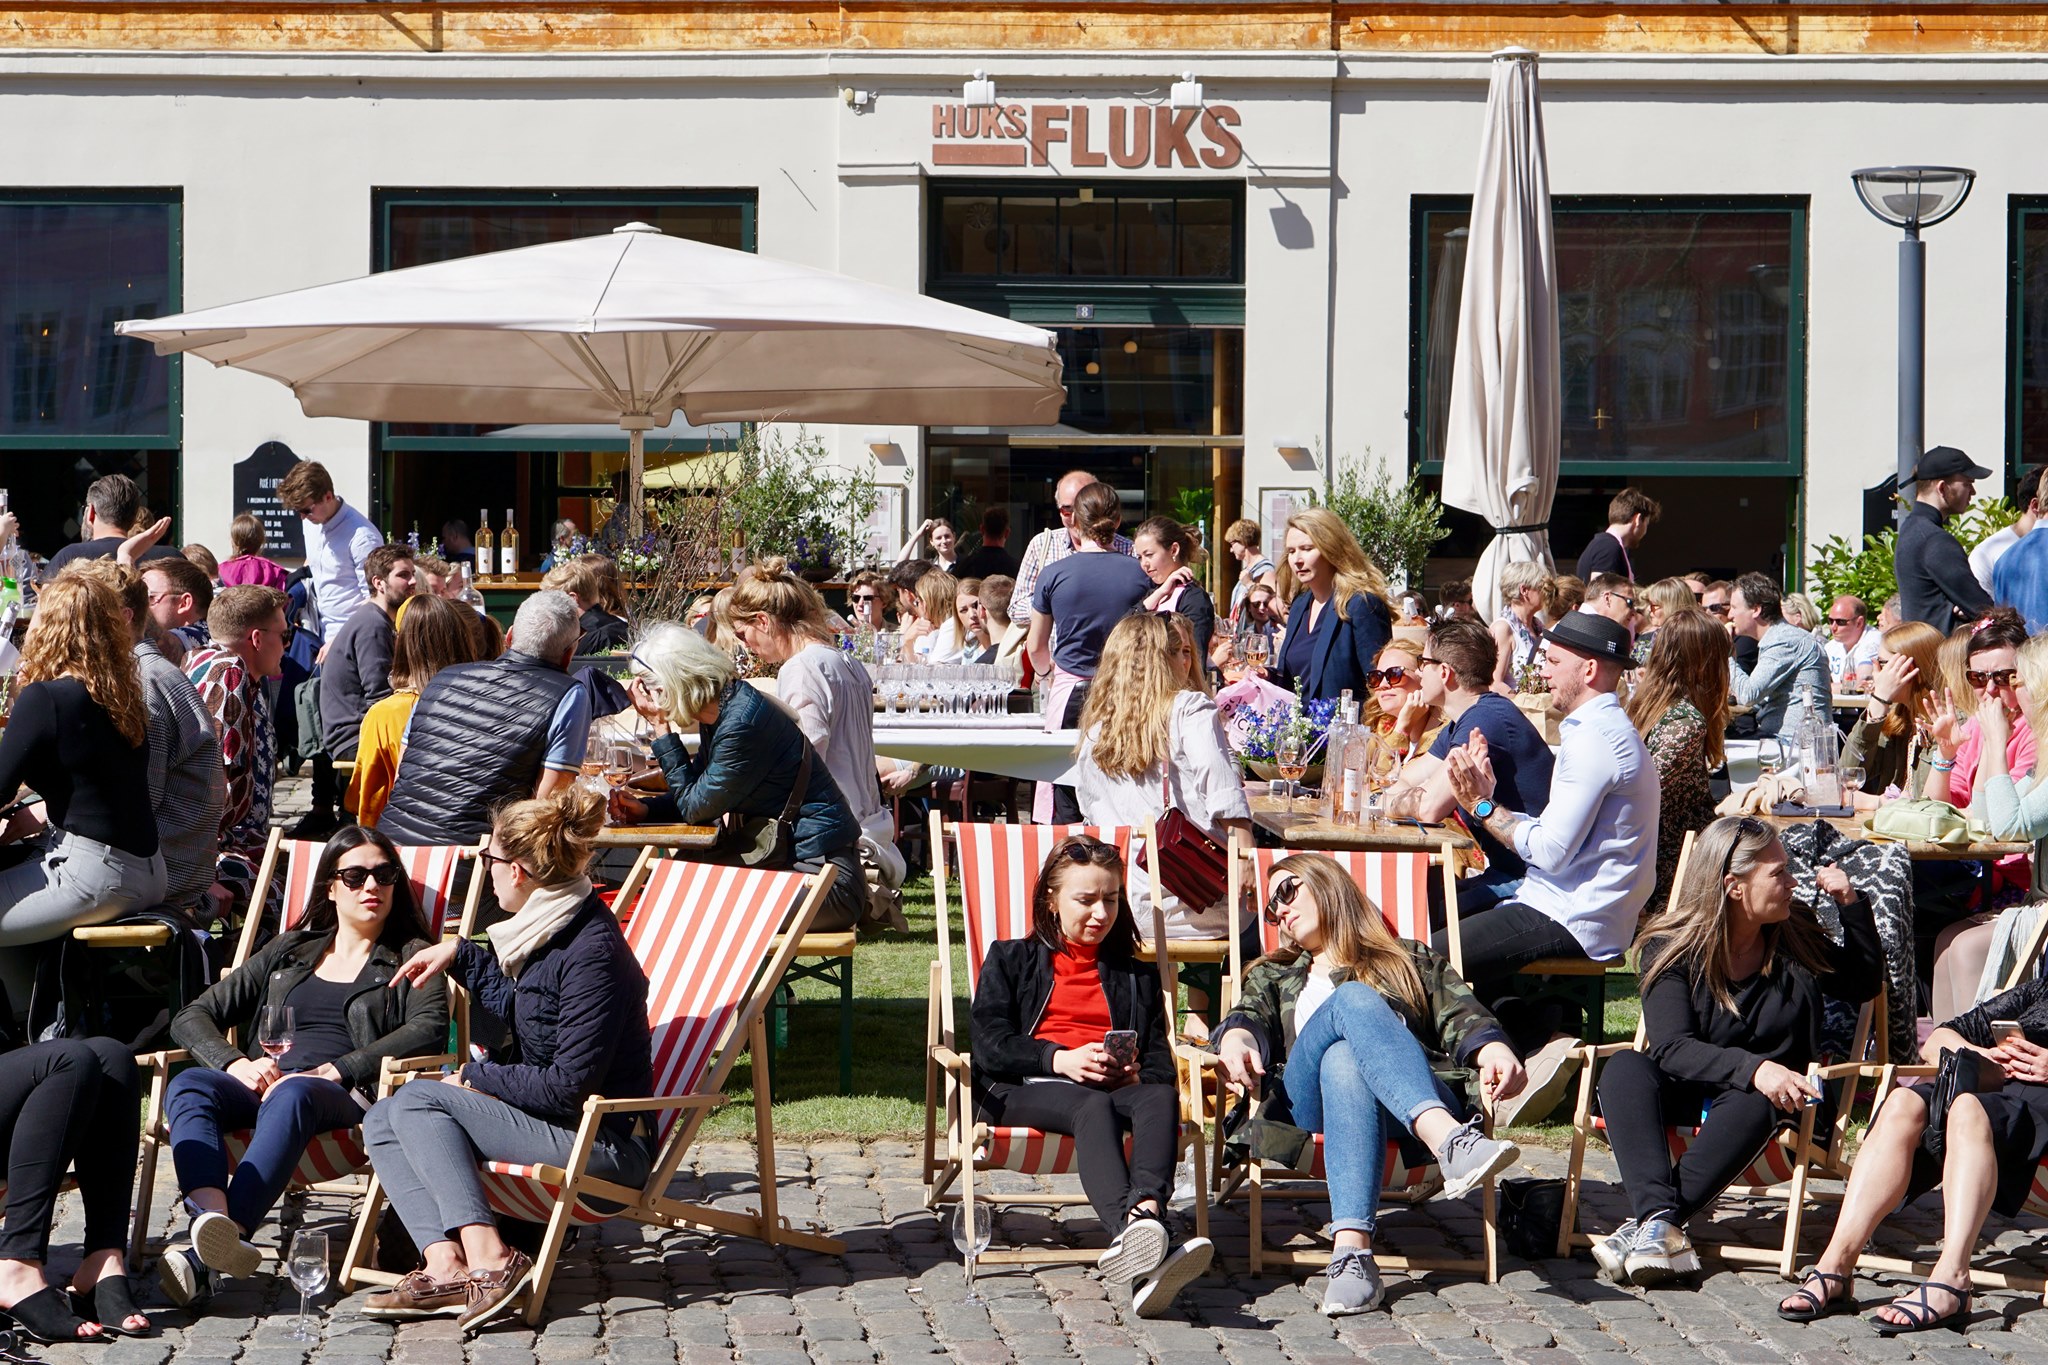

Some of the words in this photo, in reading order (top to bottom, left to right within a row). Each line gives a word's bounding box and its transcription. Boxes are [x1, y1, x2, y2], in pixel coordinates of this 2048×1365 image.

[932, 104, 1026, 138] HUKS
[1031, 105, 1242, 168] FLUKS
[1081, 306, 1088, 317] 8
